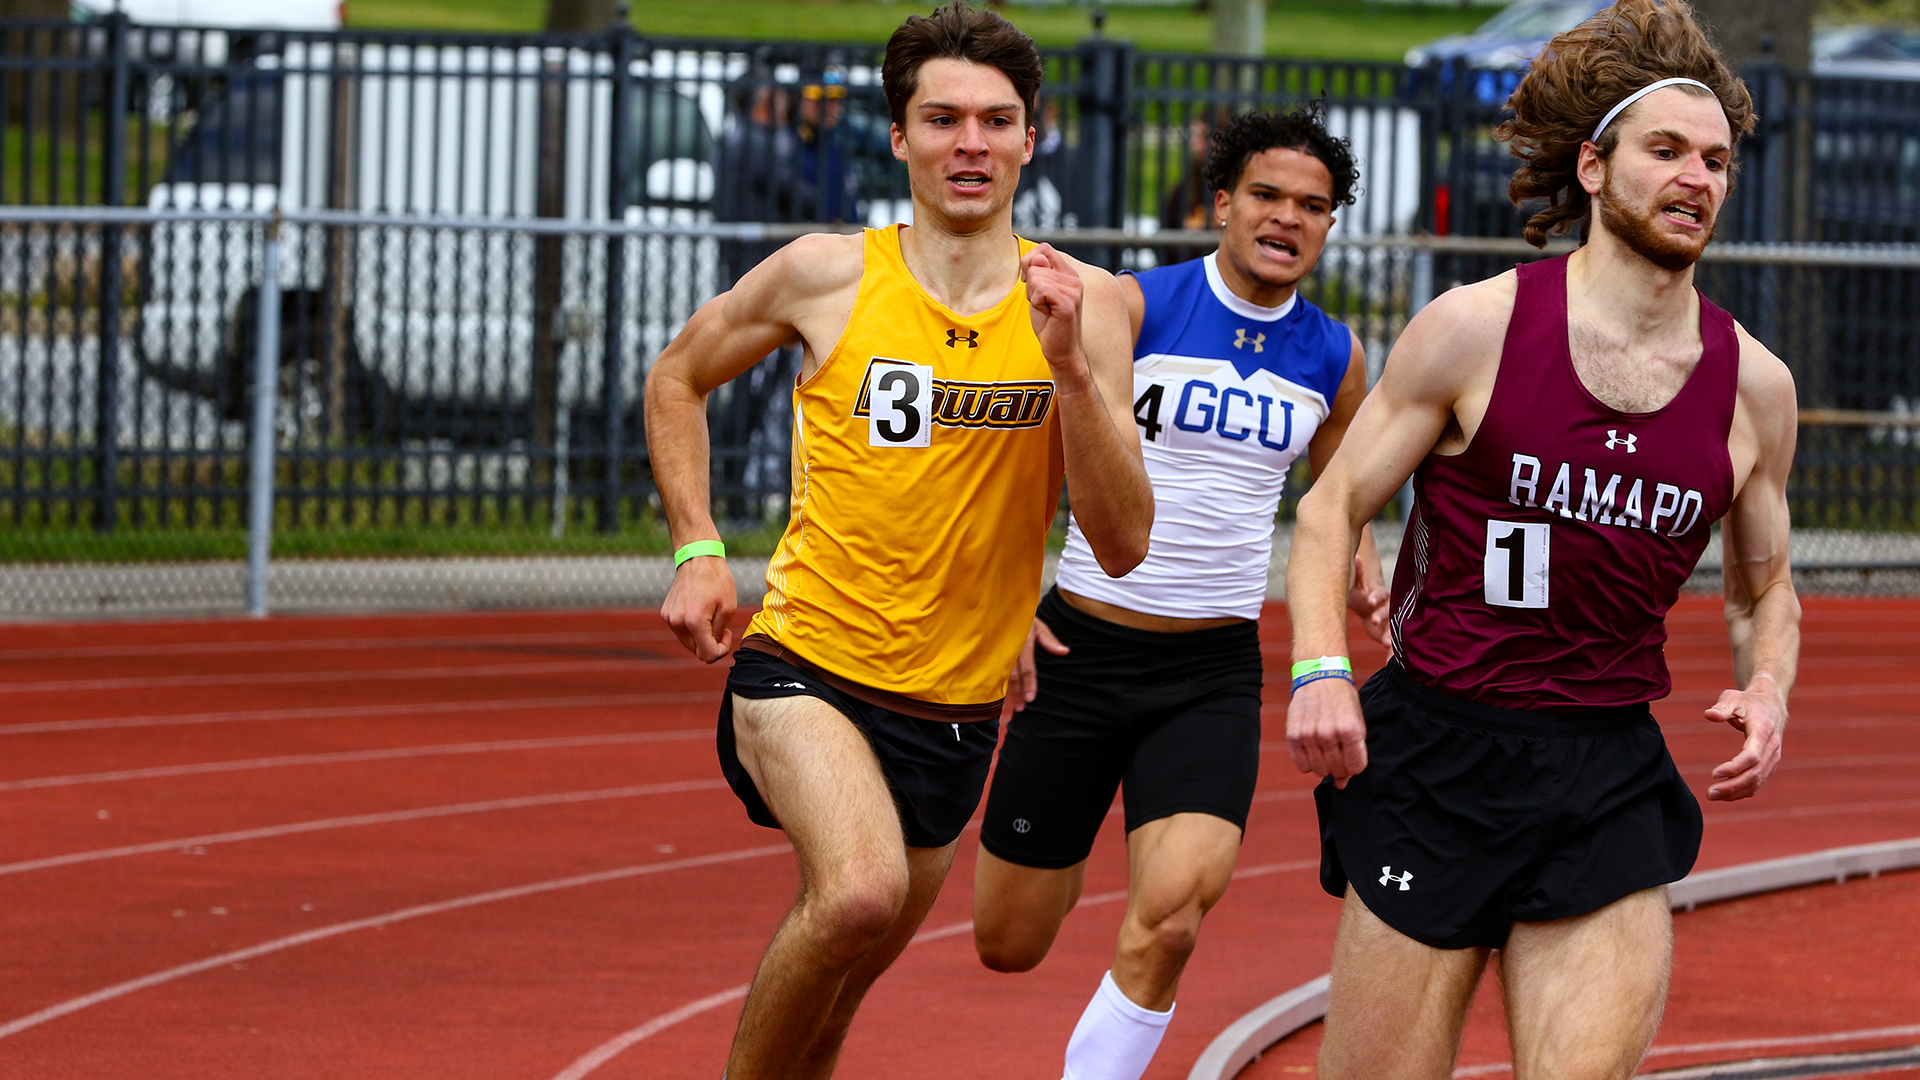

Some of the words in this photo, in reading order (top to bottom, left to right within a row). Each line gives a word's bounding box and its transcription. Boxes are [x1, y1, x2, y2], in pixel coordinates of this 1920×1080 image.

[876, 370, 921, 442] 3
[1133, 384, 1165, 442] 4
[1174, 379, 1294, 451] GCU
[1508, 453, 1703, 537] RAMAPO
[1495, 527, 1525, 601] 1
